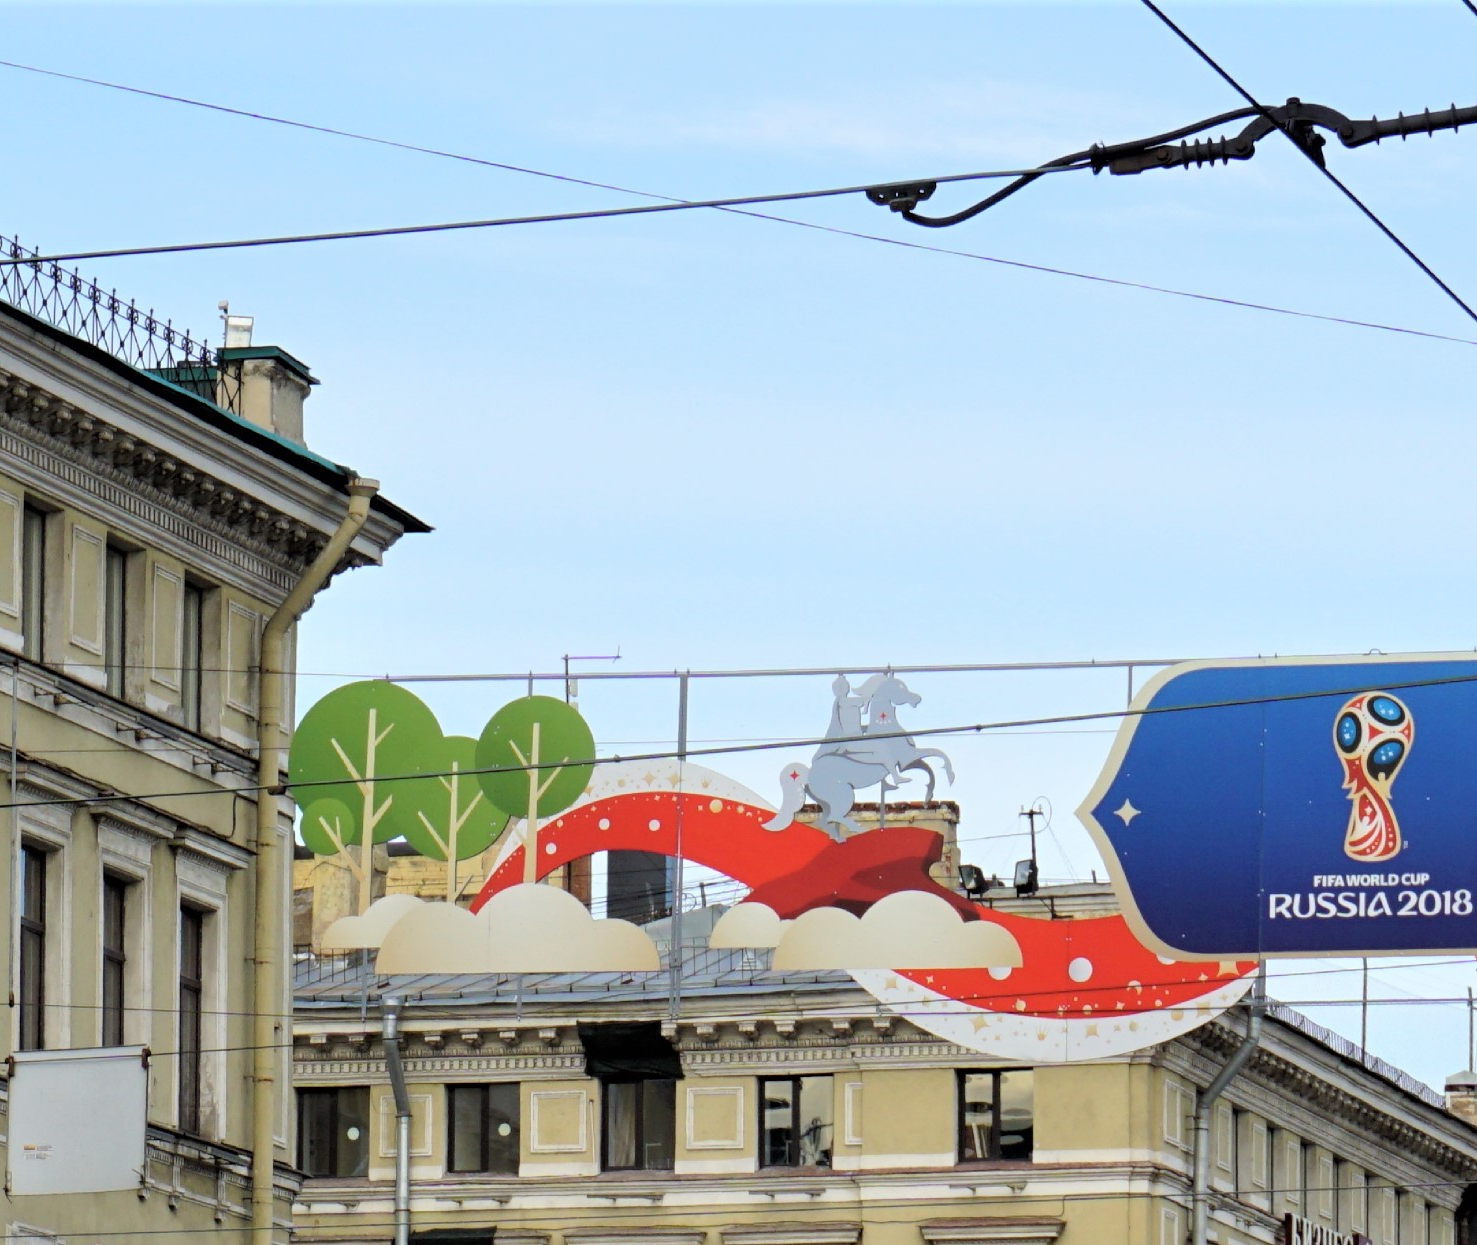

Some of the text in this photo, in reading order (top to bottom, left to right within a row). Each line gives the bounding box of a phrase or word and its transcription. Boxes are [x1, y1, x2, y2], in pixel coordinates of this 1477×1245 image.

[1313, 873, 1430, 888] FIFA WORLD CUP
[1269, 890, 1473, 919] RUSSIA 2018
